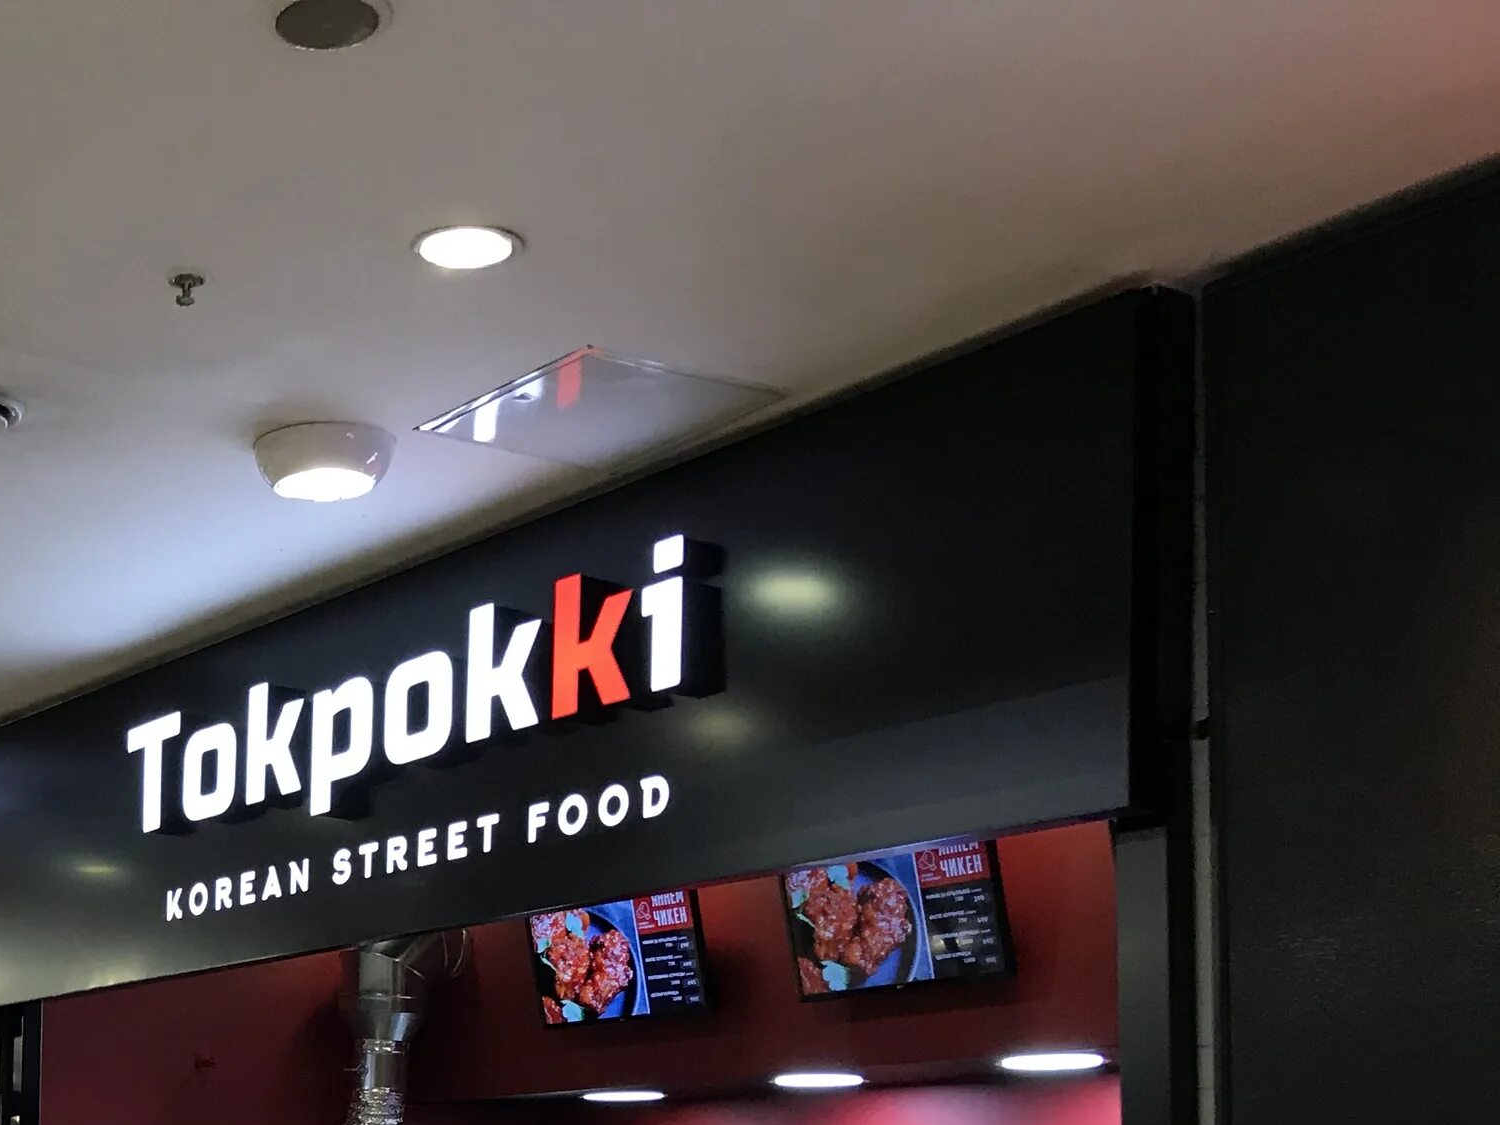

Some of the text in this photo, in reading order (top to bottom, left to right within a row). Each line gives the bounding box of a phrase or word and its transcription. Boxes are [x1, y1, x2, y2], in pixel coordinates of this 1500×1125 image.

[127, 534, 684, 832] Tokpokki
[165, 774, 670, 921] KOREAN STREET FOOD
[940, 854, 983, 878] ЧИКЕН
[653, 907, 688, 926] ЧИКЕН
